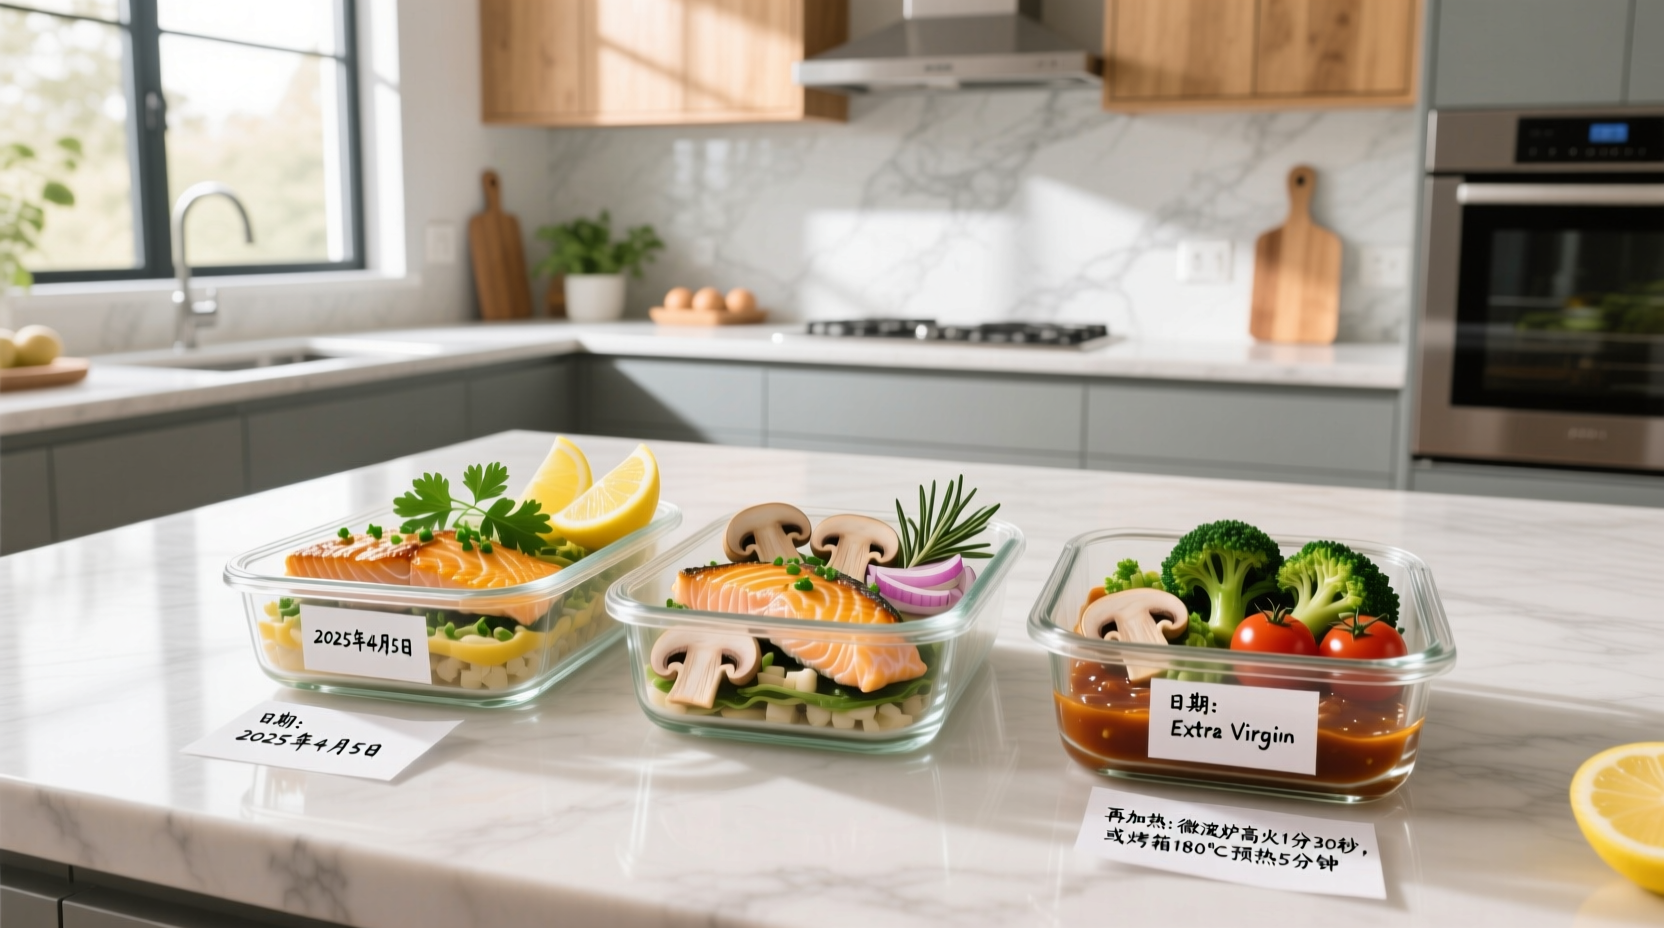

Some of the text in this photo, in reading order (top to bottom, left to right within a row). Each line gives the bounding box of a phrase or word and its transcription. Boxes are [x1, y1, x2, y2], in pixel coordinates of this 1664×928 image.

[313, 629, 412, 657] 2025年4月5日
[1170, 691, 1217, 715] 日期：
[259, 711, 304, 729] 日期：
[1170, 719, 1223, 739] Extra
[235, 729, 382, 757] 2025年4月5日
